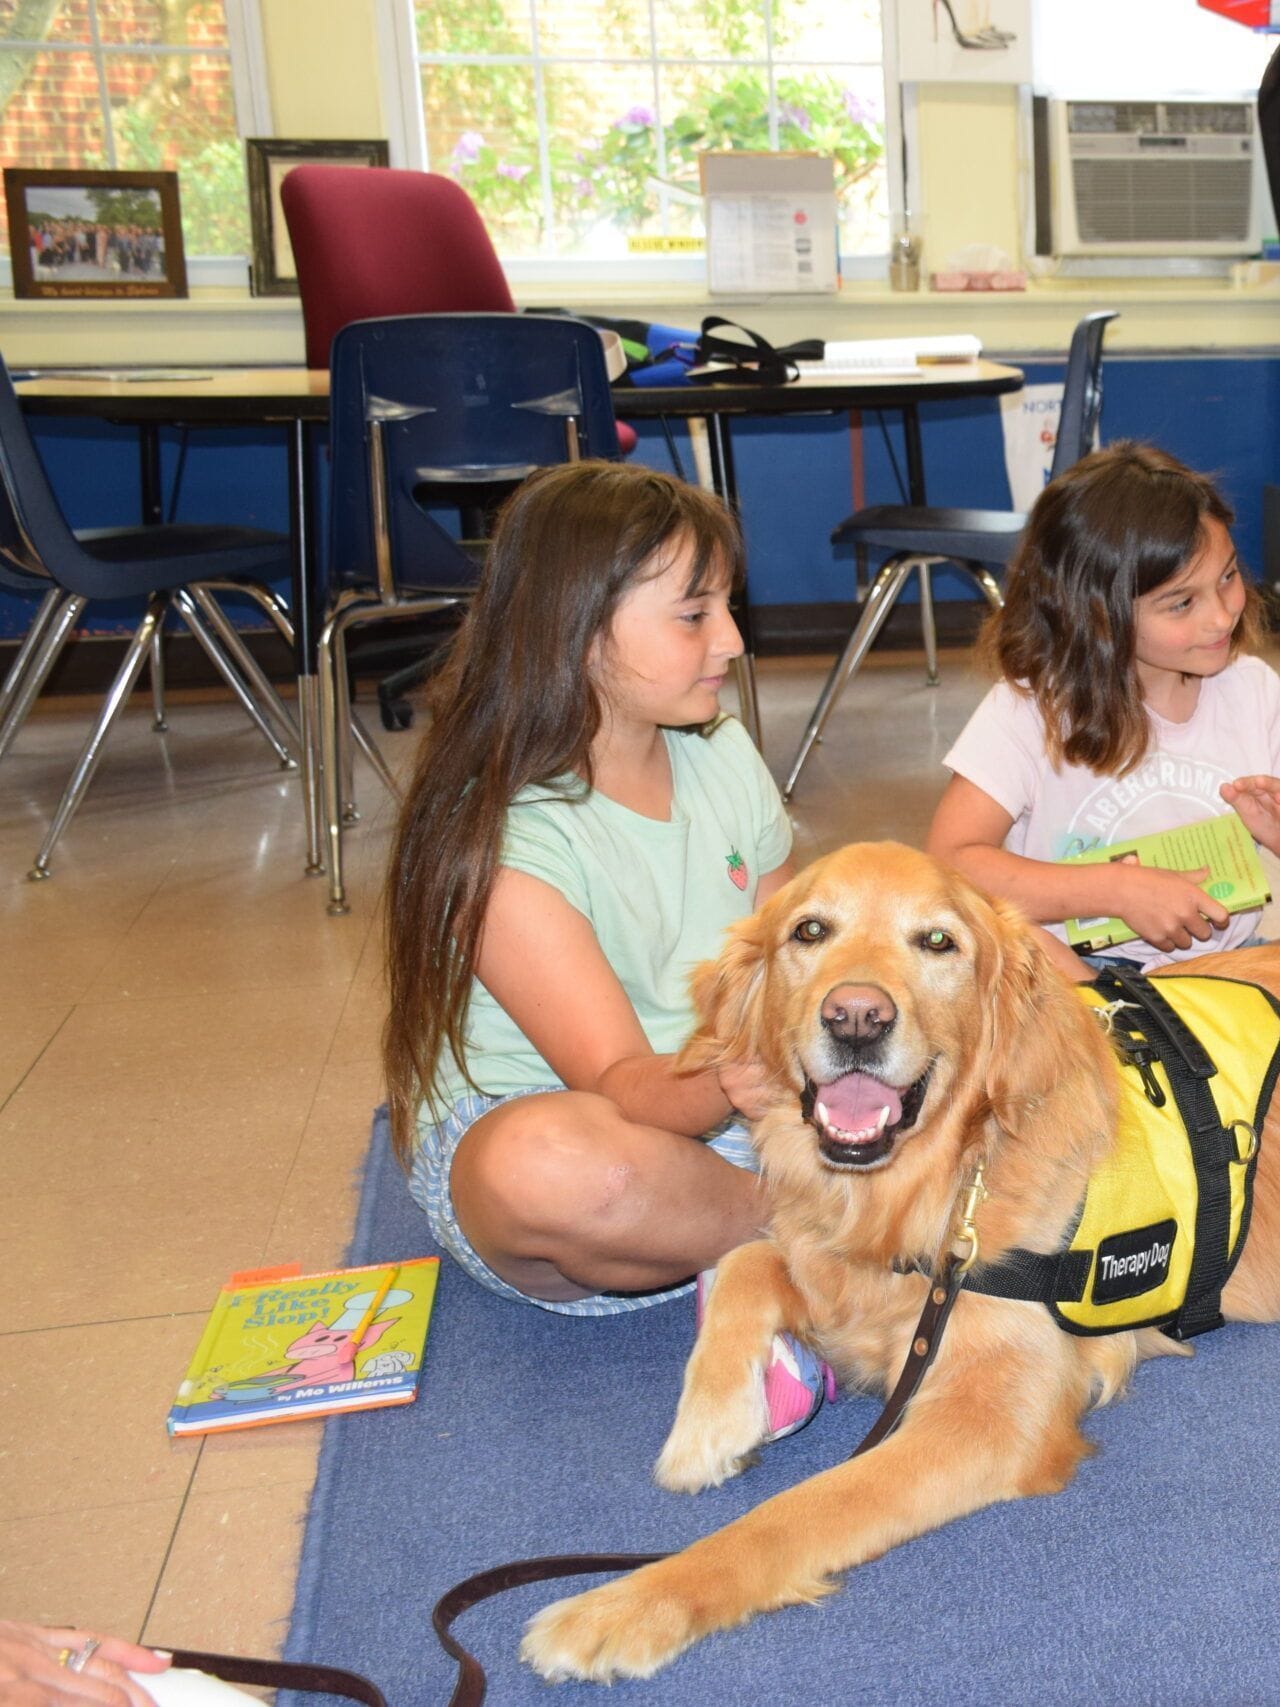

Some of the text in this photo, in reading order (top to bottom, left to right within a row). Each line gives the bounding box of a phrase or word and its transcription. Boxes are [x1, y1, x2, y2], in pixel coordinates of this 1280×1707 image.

[1101, 1242, 1170, 1281] Therapy Dog
[231, 1280, 360, 1308] I Really
[242, 1307, 331, 1329] Slop!
[255, 1298, 330, 1316] Like
[295, 1387, 325, 1399] Mo
[328, 1376, 403, 1394] Willems
